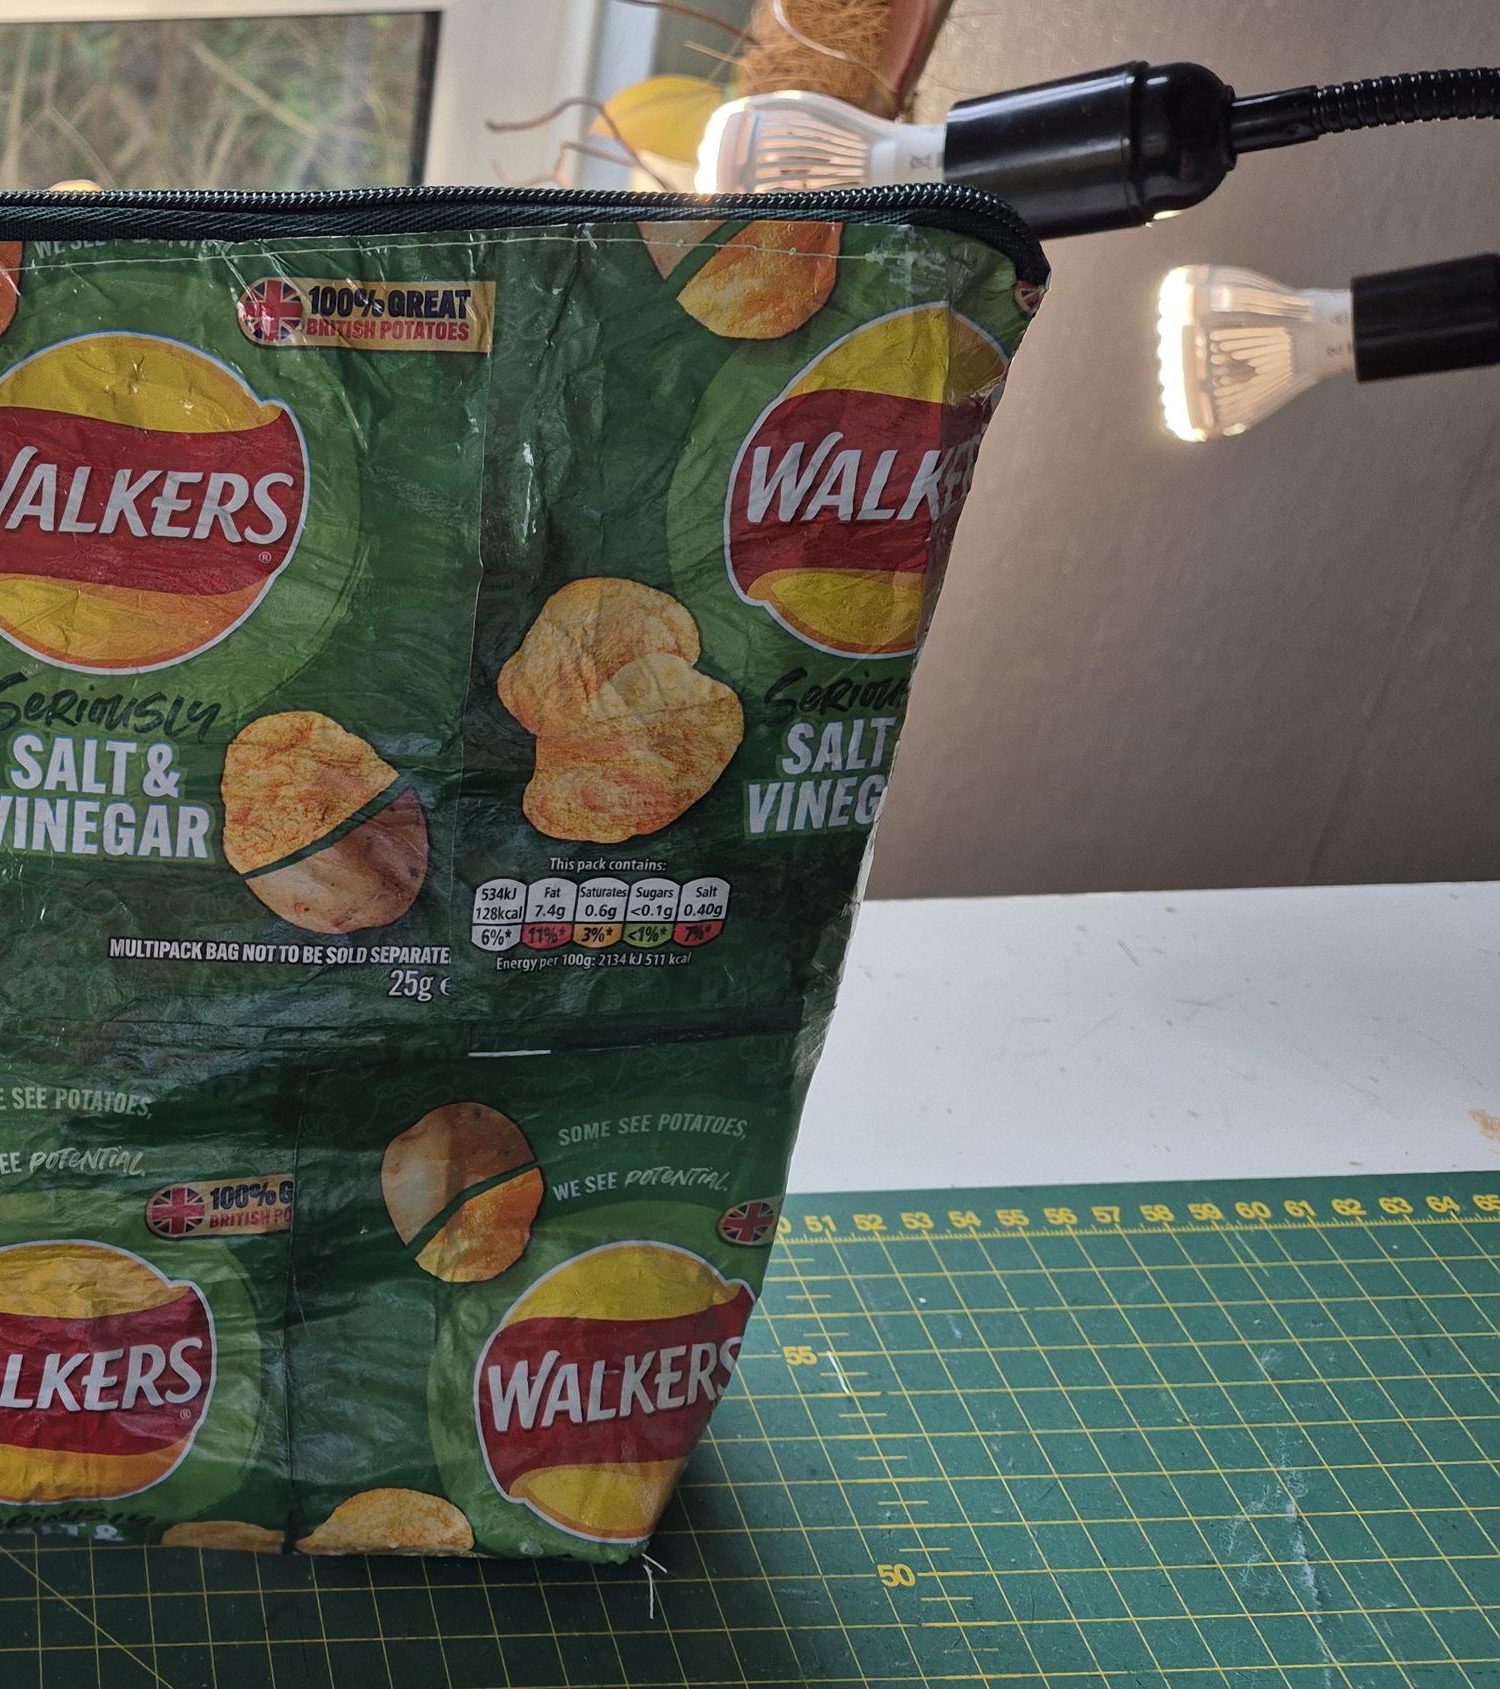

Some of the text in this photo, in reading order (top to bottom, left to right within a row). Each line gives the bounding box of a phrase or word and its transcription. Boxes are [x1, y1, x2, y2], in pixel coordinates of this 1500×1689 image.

[308, 286, 471, 319] 100% GREAT
[306, 318, 469, 341] BRITISH POTATOES
[781, 716, 898, 775] SALT
[10, 733, 182, 799] SALT &
[549, 857, 667, 873] This pack contains:
[481, 887, 517, 901] 534kJ
[544, 886, 561, 898] Fat
[579, 886, 628, 898] Saturates
[636, 886, 674, 901] Sugars
[695, 885, 718, 898] Salt
[475, 906, 523, 920] 128kcal
[535, 904, 566, 919] 7.4g
[584, 904, 617, 920] 0.6g
[630, 904, 673, 920] <0.1g
[683, 903, 724, 918] 0.40g
[109, 938, 204, 960] MULTIPACK
[206, 942, 239, 961] BAG
[242, 944, 277, 963] NOT
[279, 945, 299, 963] TO
[303, 946, 324, 964] BE
[325, 946, 368, 964] SOLD
[496, 951, 692, 972] Energy per 100g: 2134 kJ 511 kcal
[388, 969, 434, 1002] 25g
[11, 1086, 48, 1110] SEE
[55, 1086, 152, 1120] POTATOES,
[557, 1112, 748, 1147] SOME SEE POTATOES,
[210, 1180, 294, 1210] 100% G
[552, 1178, 581, 1201] WE
[585, 1171, 618, 1194] SEE
[209, 1209, 270, 1229] BRITISH
[804, 1215, 837, 1232] 51
[853, 1213, 886, 1230] 52
[901, 1211, 934, 1229] 53
[948, 1210, 981, 1228] 54
[996, 1209, 1029, 1226] 55
[1044, 1207, 1078, 1225] 56
[1091, 1206, 1122, 1223] 57
[1139, 1204, 1174, 1222] 58
[1188, 1203, 1224, 1220] 59
[1235, 1201, 1271, 1219] 60
[1284, 1200, 1316, 1217] 61
[1332, 1198, 1367, 1216] 62
[1379, 1197, 1414, 1215] 63
[1426, 1195, 1460, 1213] 64
[783, 1345, 818, 1366] 55
[878, 1563, 916, 1588] 50
